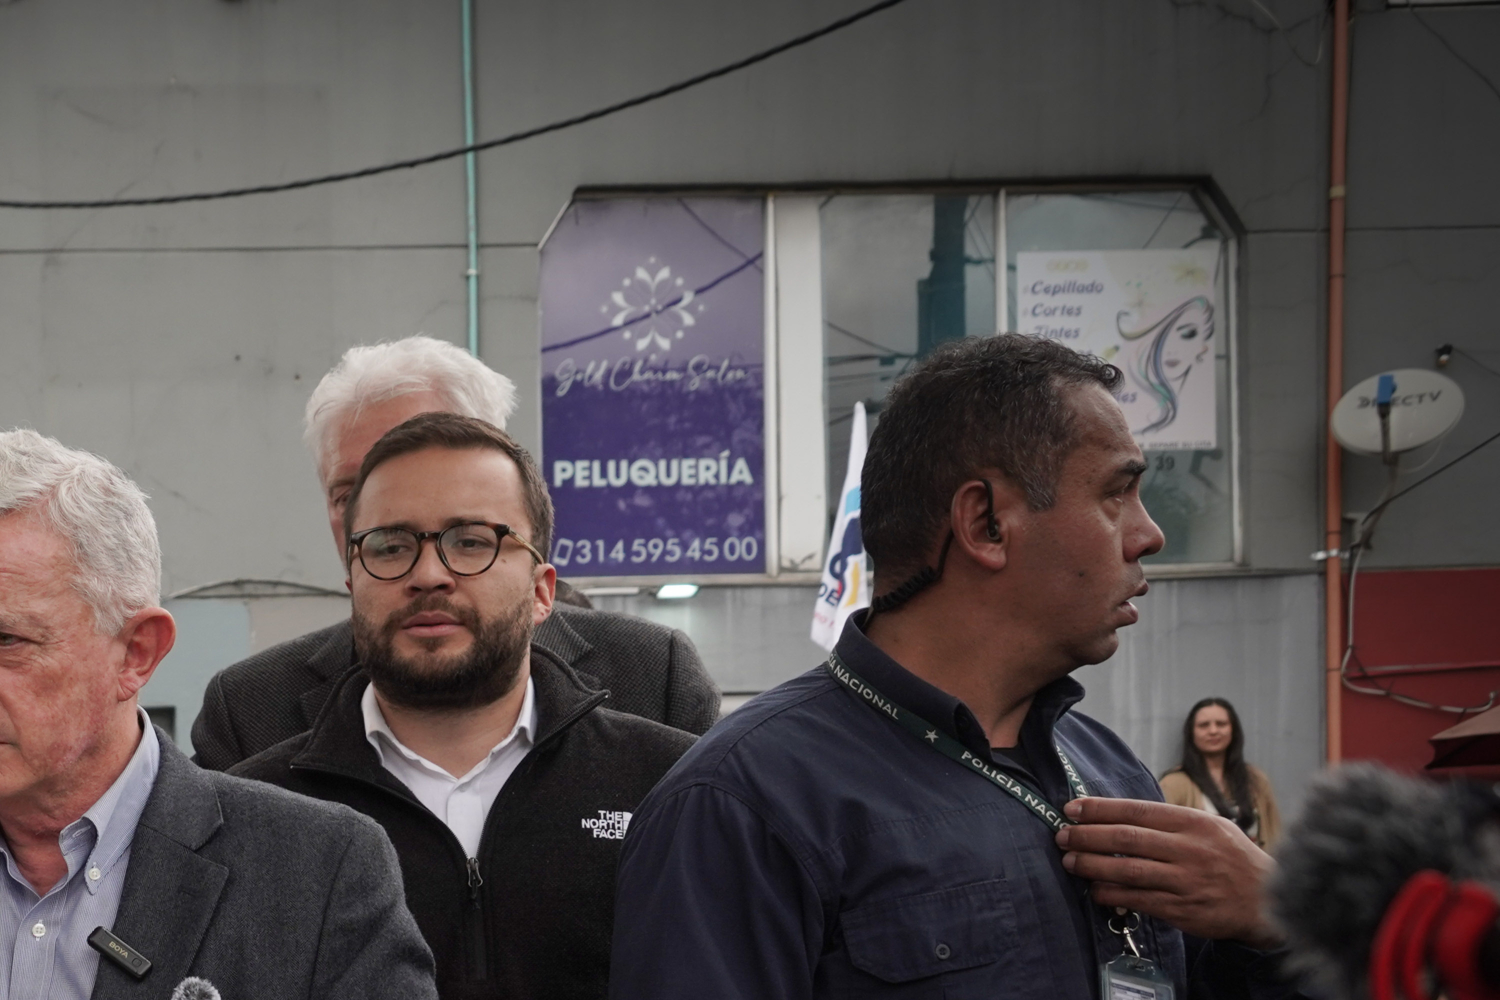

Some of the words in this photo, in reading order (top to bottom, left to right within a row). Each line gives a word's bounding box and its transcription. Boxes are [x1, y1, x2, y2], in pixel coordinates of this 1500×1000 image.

[1031, 280, 1104, 297] Cepillado
[1031, 302, 1082, 317] Cortes
[1357, 390, 1442, 409] DIECTV
[553, 449, 754, 487] PELUQUERÍA
[833, 665, 900, 721] NACIONAL
[961, 751, 1023, 797] POLICÍA
[598, 810, 623, 820] THE
[581, 818, 623, 830] NORTH
[593, 828, 624, 839] FACE
[108, 941, 129, 959] BOYA
